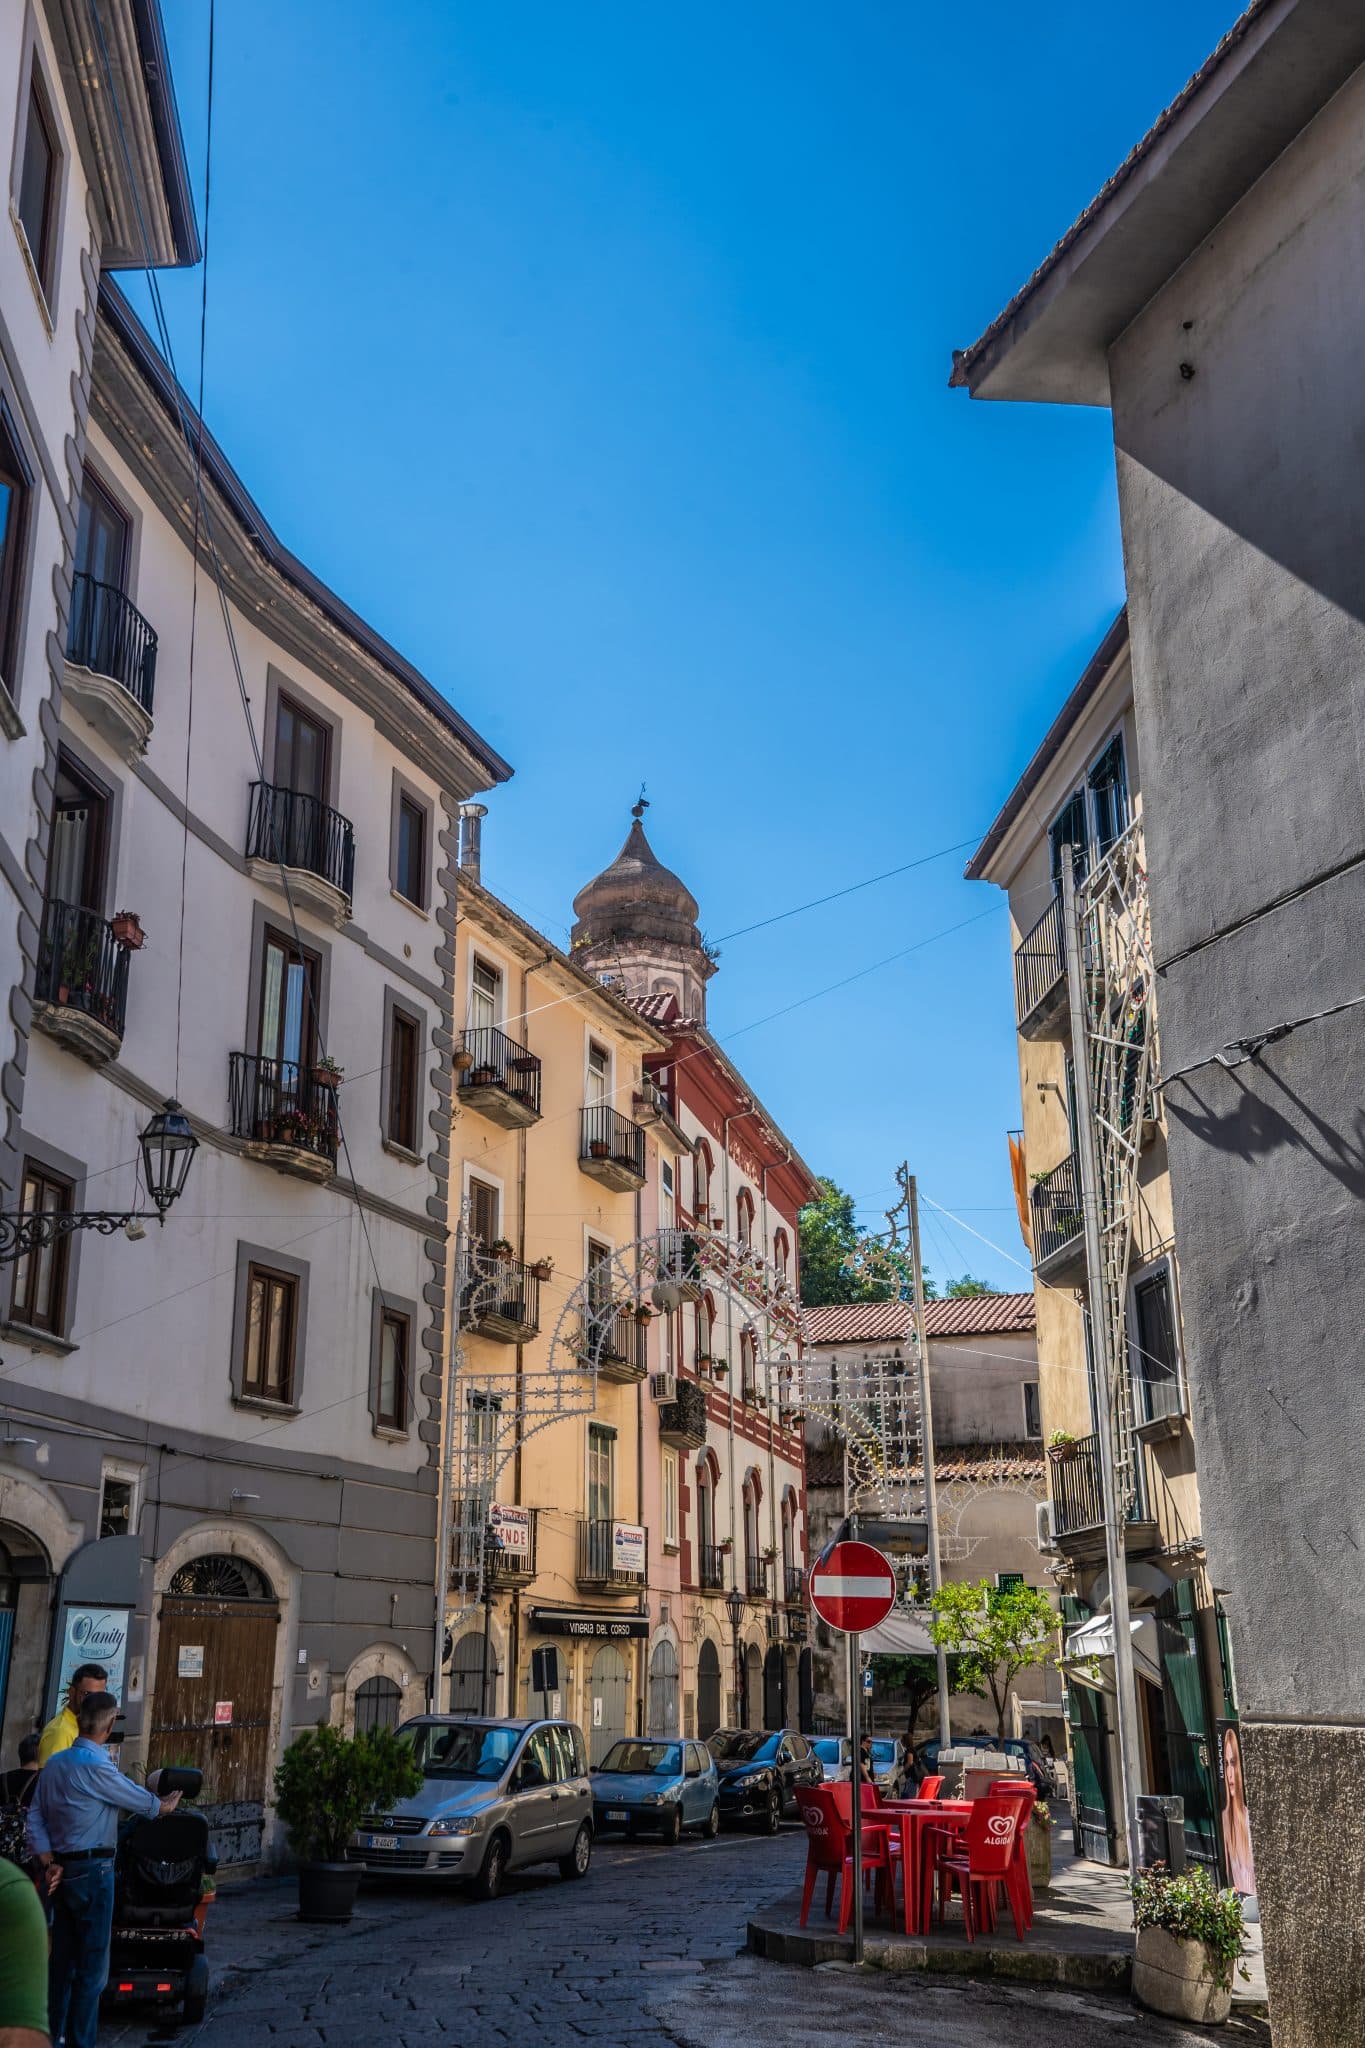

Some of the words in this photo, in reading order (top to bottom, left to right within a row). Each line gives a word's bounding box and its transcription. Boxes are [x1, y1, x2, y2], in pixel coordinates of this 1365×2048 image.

[76, 1614, 125, 1660] Vanity
[610, 1624, 631, 1635] CORSO
[865, 1671, 872, 1686] P
